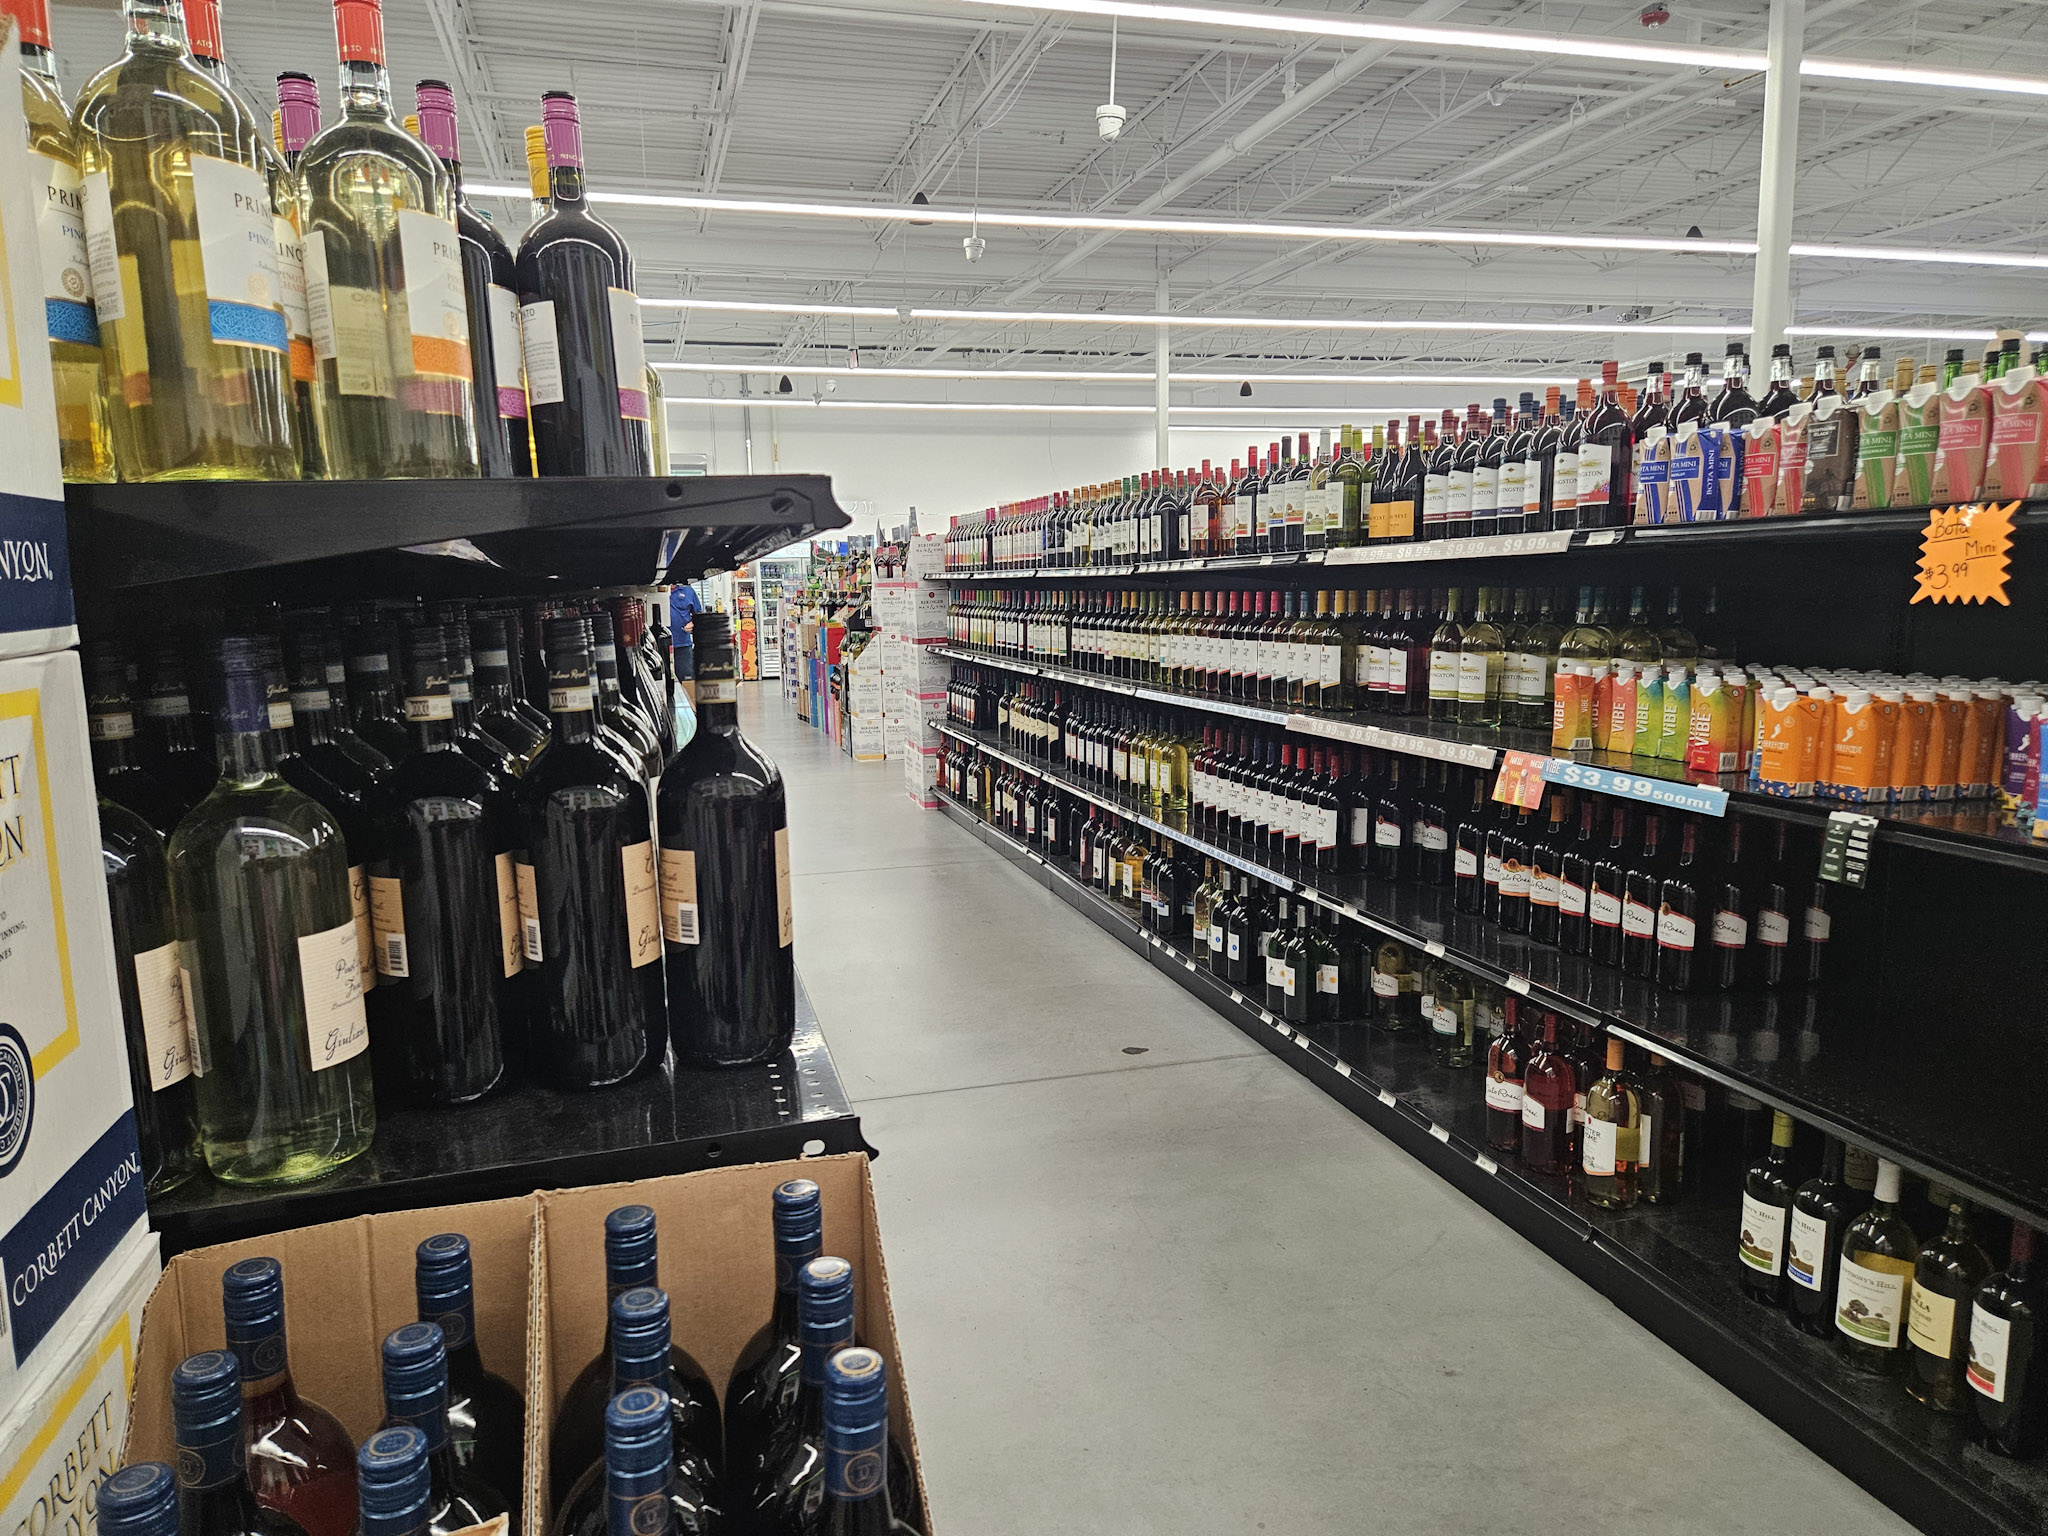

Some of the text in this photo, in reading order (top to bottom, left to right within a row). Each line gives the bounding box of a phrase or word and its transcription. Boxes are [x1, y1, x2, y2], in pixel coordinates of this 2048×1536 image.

[1956, 425, 1977, 433] MINI
[2010, 419, 2034, 428] MINI
[1872, 436, 1892, 445] MINI
[1914, 430, 1937, 438] MINI
[1680, 460, 1696, 468] MINI
[1706, 474, 1714, 496] BOTA
[1932, 517, 1969, 539] Bota
[1397, 546, 1430, 559] $9.99
[1448, 542, 1484, 555] $9.99
[1503, 537, 1546, 551] $9.99
[1965, 540, 1997, 556] Mini
[1924, 562, 1968, 590] $3.99
[1311, 721, 1336, 736] $9.99
[1349, 729, 1377, 743] $9.99
[1391, 735, 1423, 751] $9.99
[1439, 743, 1475, 761] $9.99
[1510, 757, 1524, 766] NEW
[1530, 760, 1544, 769] NEW
[1563, 766, 1652, 797] $3.99
[1652, 790, 1714, 811] 500mL
[1594, 900, 1614, 913] Rossi
[1625, 909, 1647, 924] Rossi
[1663, 921, 1688, 936] Rossi
[1715, 920, 1740, 934] Rossi
[1497, 1087, 1522, 1100] Rossi
[12, 1213, 81, 1307] CORBETT
[1877, 1280, 1897, 1290] HILL
